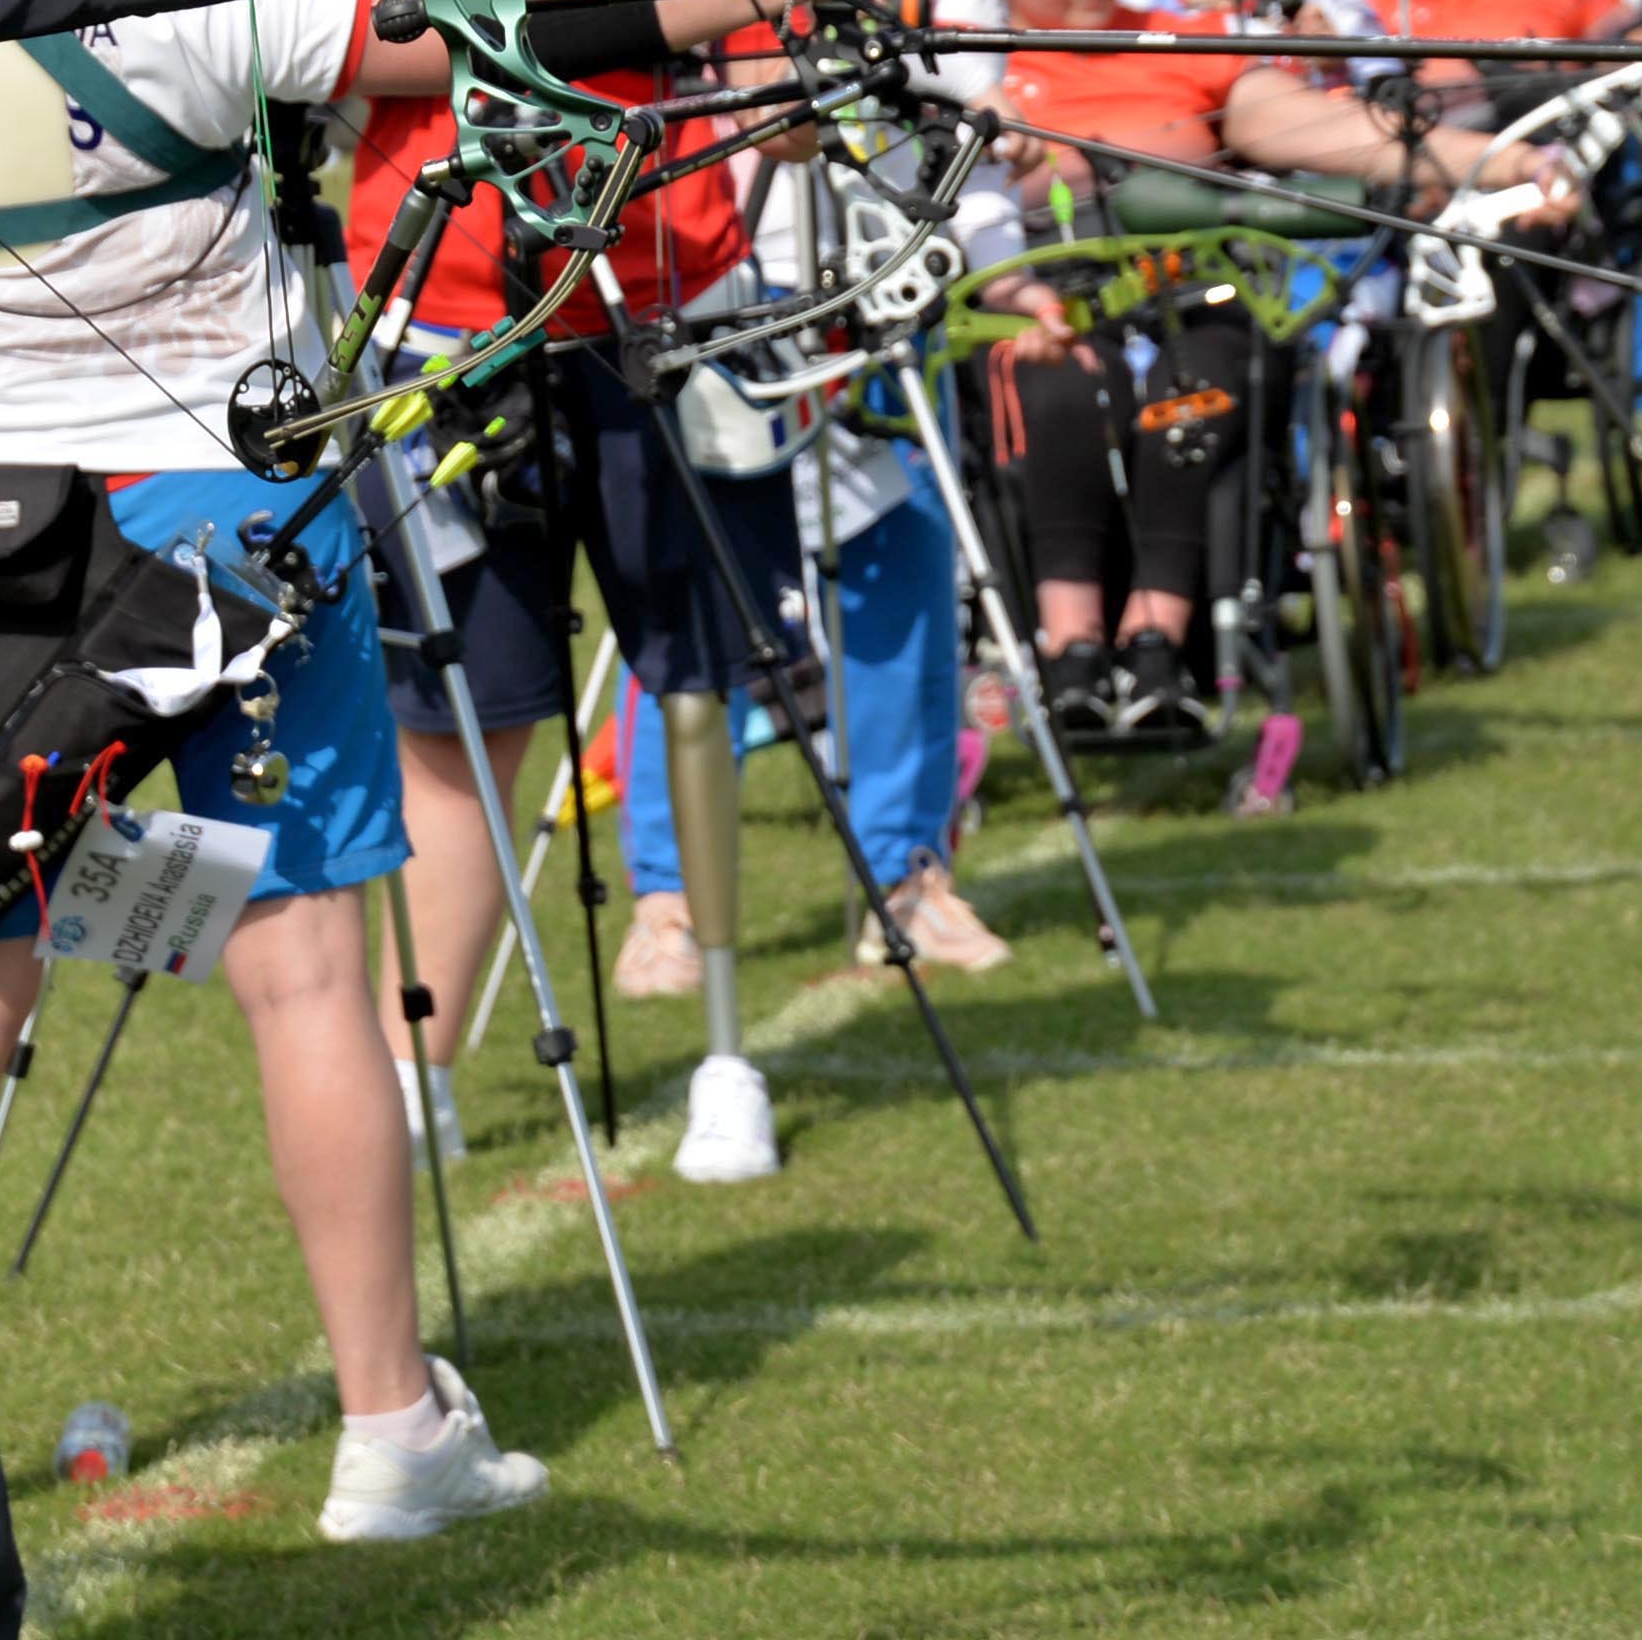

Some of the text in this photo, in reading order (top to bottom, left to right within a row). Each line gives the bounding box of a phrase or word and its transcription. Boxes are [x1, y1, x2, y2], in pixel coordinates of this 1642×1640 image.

[69, 850, 129, 904] 35A
[111, 821, 204, 963] DZHIOEVA Anastasia
[167, 893, 217, 952] Russia
